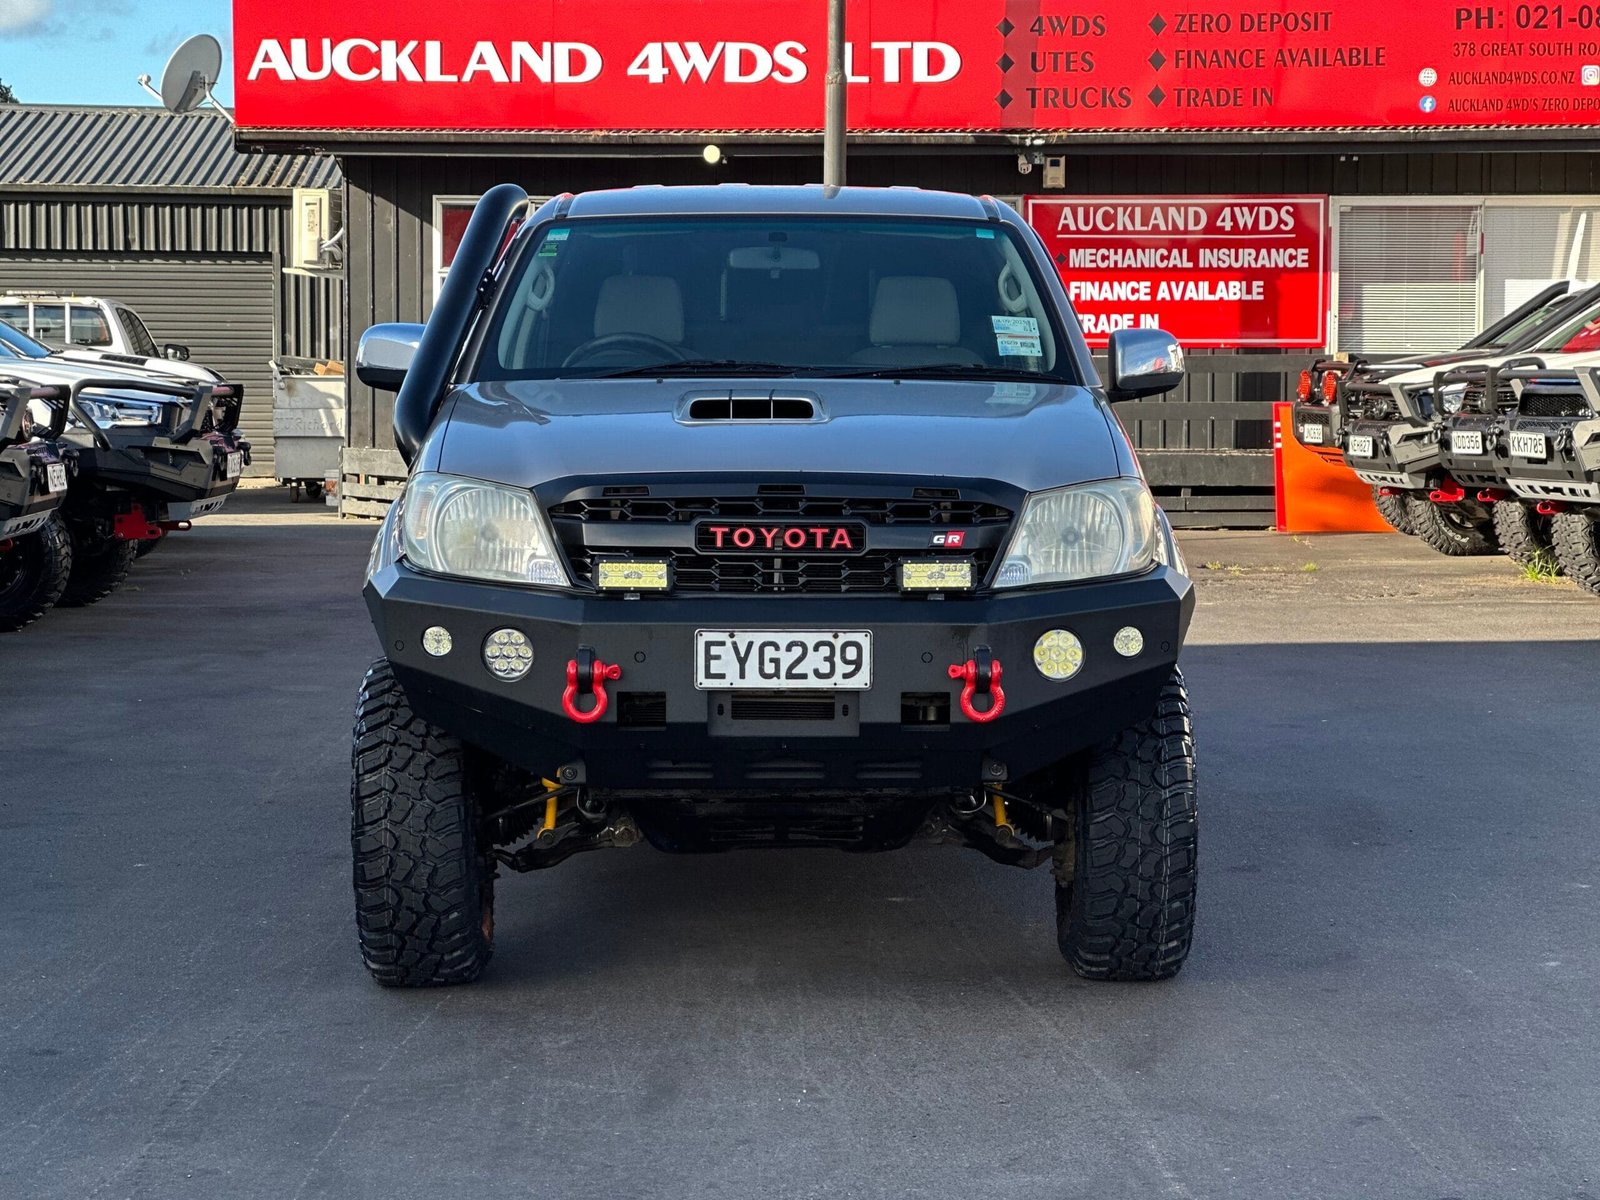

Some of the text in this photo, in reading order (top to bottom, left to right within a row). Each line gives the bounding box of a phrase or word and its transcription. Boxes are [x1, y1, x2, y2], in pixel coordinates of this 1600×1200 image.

[1030, 15, 1106, 37] 4WDS
[1174, 12, 1333, 33] ZERO DEPOSIT
[1455, 7, 1504, 30] PH:
[1175, 47, 1386, 69] FINANCE AVAILABLE
[1453, 42, 1476, 57] 378
[1481, 42, 1525, 57] GREAT
[1529, 42, 1573, 57] SOUTH
[247, 38, 963, 85] AUCKLAND 4WDS LTD
[1030, 51, 1095, 73] UTES
[1449, 71, 1575, 86] AUCKLAND4WDS.CO.NZ
[1026, 87, 1132, 109] TRUCKS
[1173, 87, 1273, 107] TRADE IN
[1449, 98, 1503, 112] AUCKLAND
[1506, 98, 1538, 112] 4WD'S
[1542, 98, 1569, 111] ZERO
[1057, 205, 1296, 232] AUCKLAND 4WDS
[1069, 248, 1309, 269] MECHANICAL INSURANCE
[1069, 281, 1264, 301] FINANCE AVAILABLE
[1140, 313, 1159, 329] IN
[709, 526, 853, 549] TOYOTA
[932, 535, 961, 544] GR
[703, 640, 864, 680] EYG239
